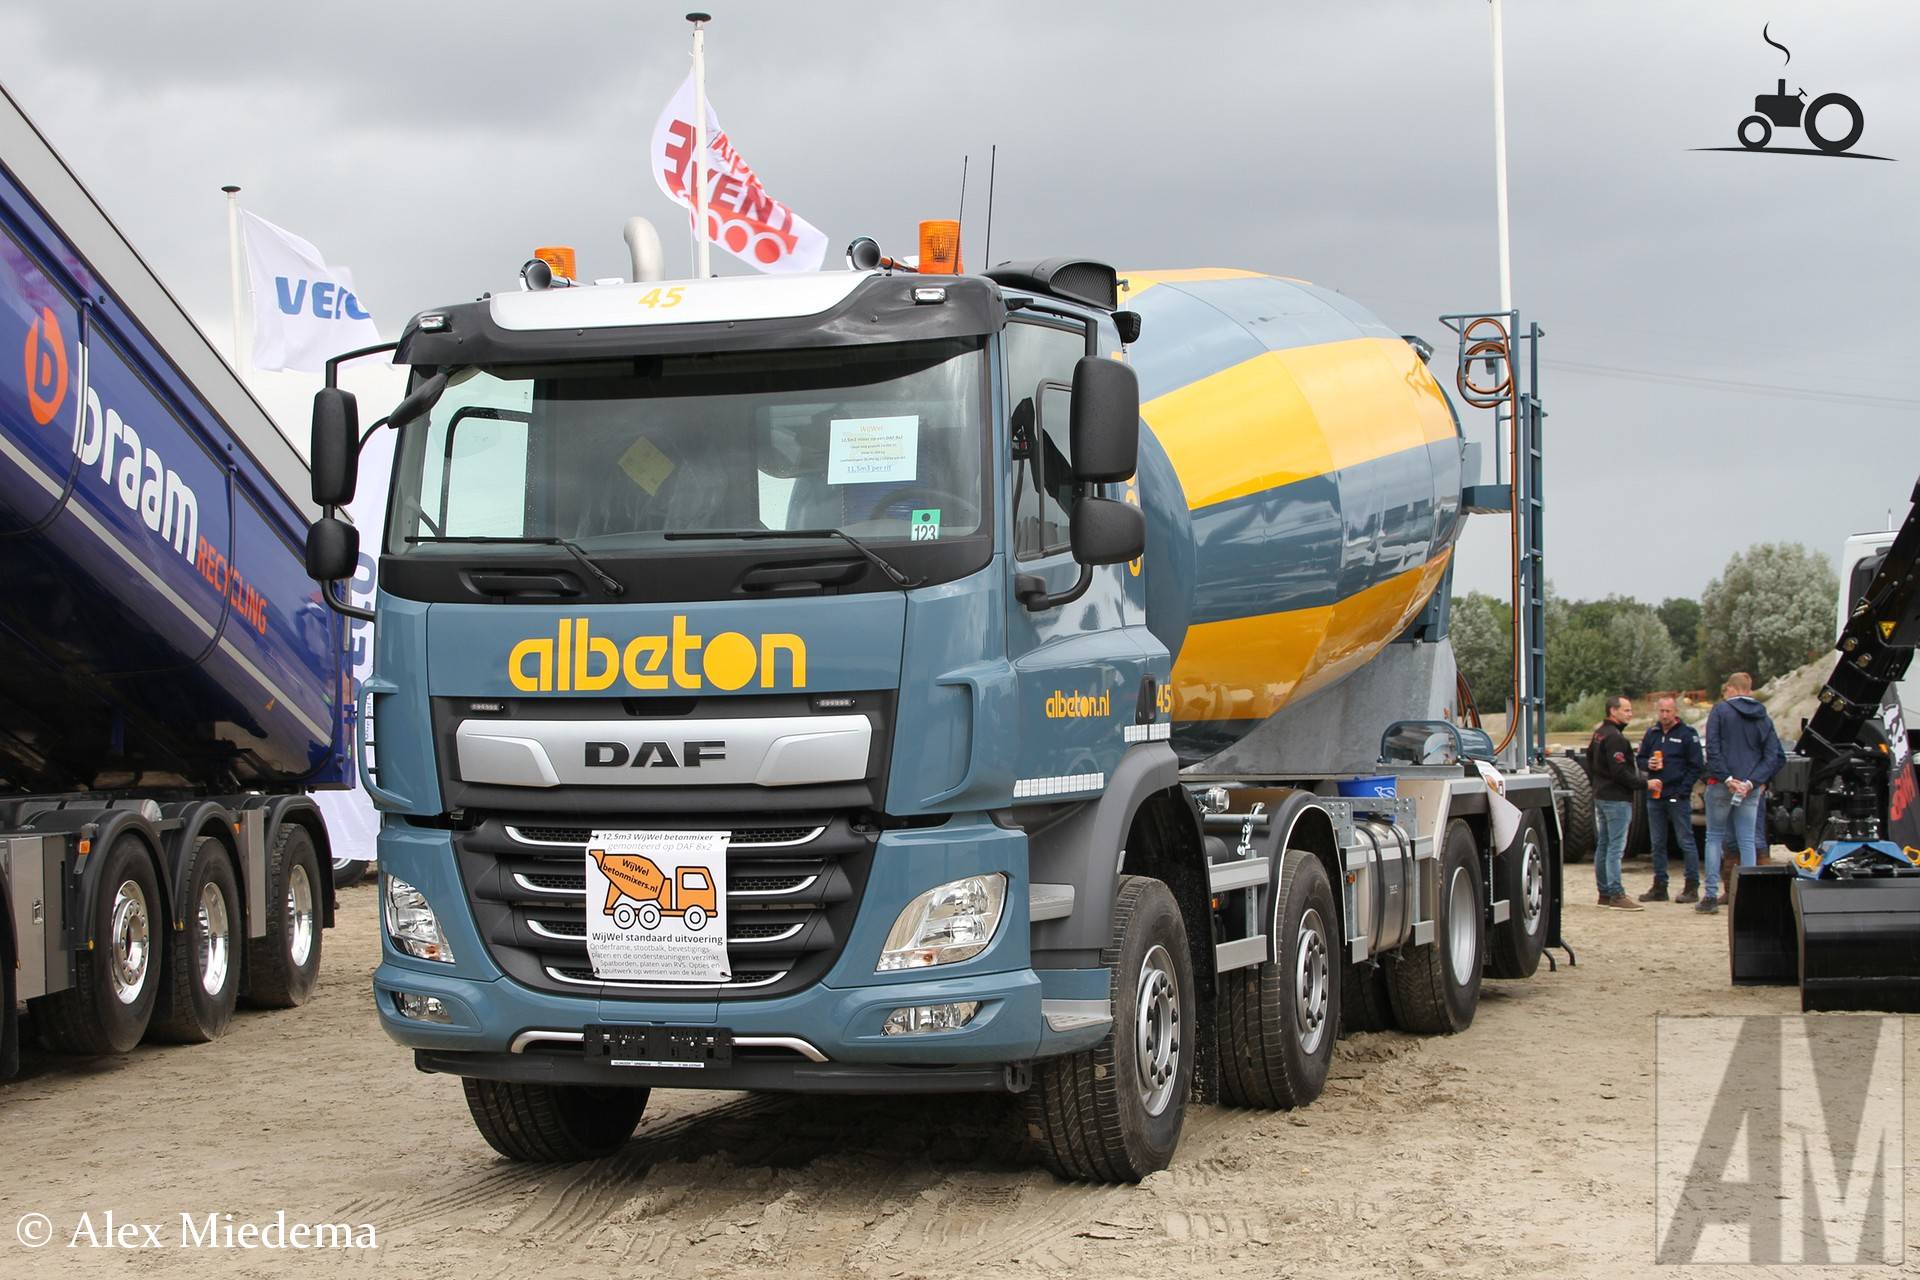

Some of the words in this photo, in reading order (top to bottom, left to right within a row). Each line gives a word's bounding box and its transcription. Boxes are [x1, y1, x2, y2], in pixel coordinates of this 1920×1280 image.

[638, 287, 686, 309] 45
[72, 340, 199, 565] braam
[914, 525, 936, 540] 123
[197, 535, 268, 635] RECYCLING
[508, 615, 807, 692] albeton
[1045, 688, 1110, 718] albeton.nl
[1156, 684, 1171, 713] 45
[584, 741, 726, 768] DAF
[608, 842, 661, 851] gemonteerd
[633, 833, 663, 842] WijWel
[664, 833, 713, 841] betonmixer
[602, 863, 659, 893] betonmixers.nl
[622, 858, 650, 877] WijWel
[592, 932, 624, 943] WijWel
[625, 933, 673, 942] standaard
[675, 934, 724, 946] uitvoering
[633, 953, 690, 961] ondersteuningen
